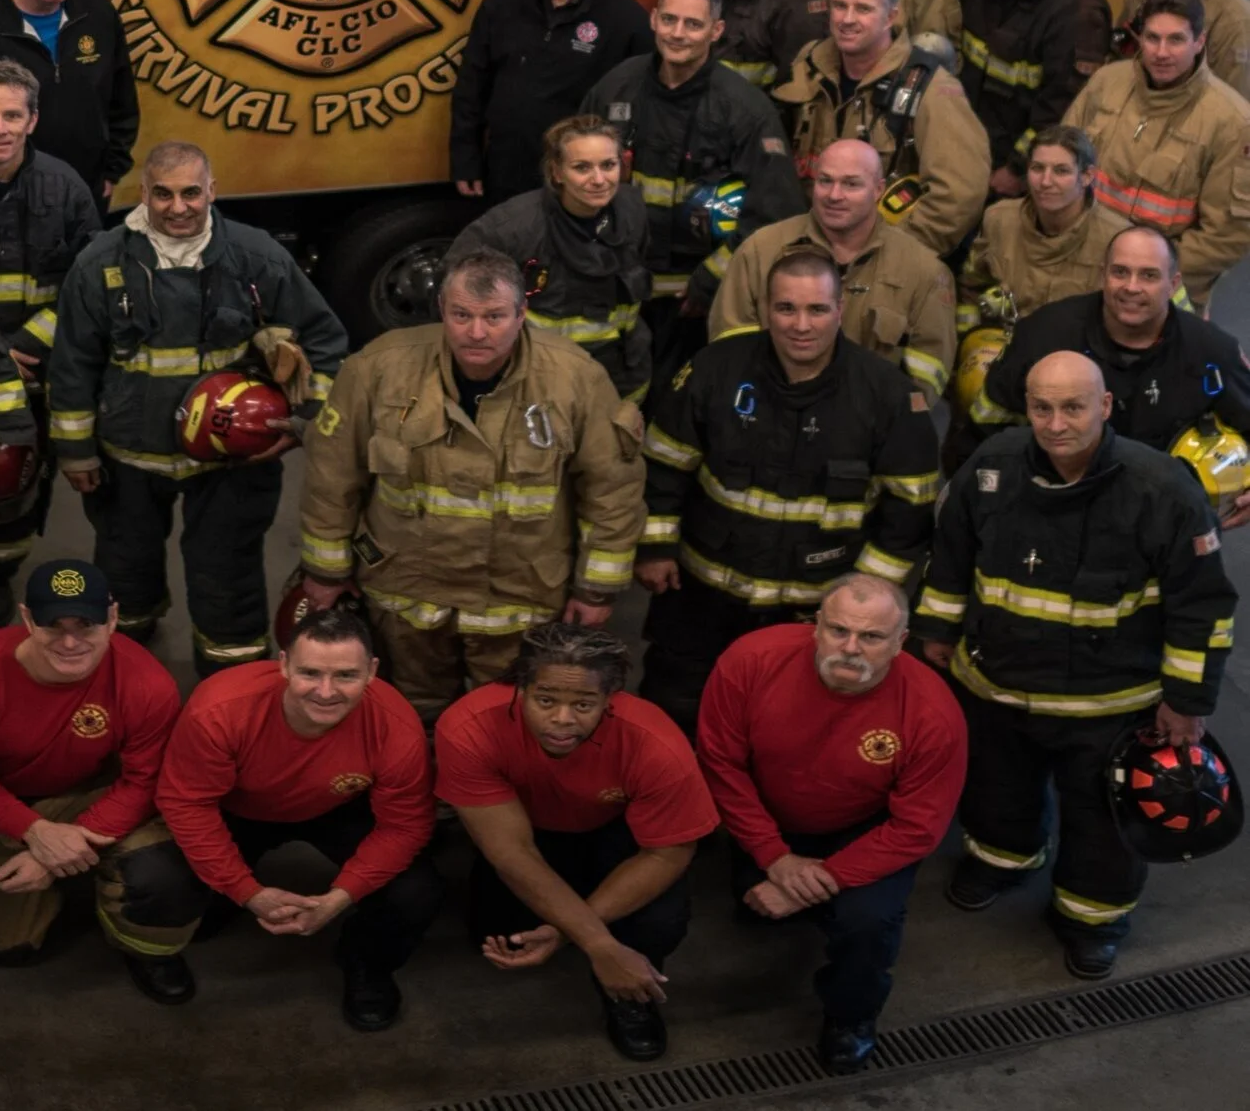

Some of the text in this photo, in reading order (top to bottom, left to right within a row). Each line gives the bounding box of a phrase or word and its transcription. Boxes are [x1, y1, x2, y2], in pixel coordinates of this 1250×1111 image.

[258, 0, 398, 36] AFL-CIO
[297, 34, 363, 57] CLC
[314, 33, 471, 135] PROG
